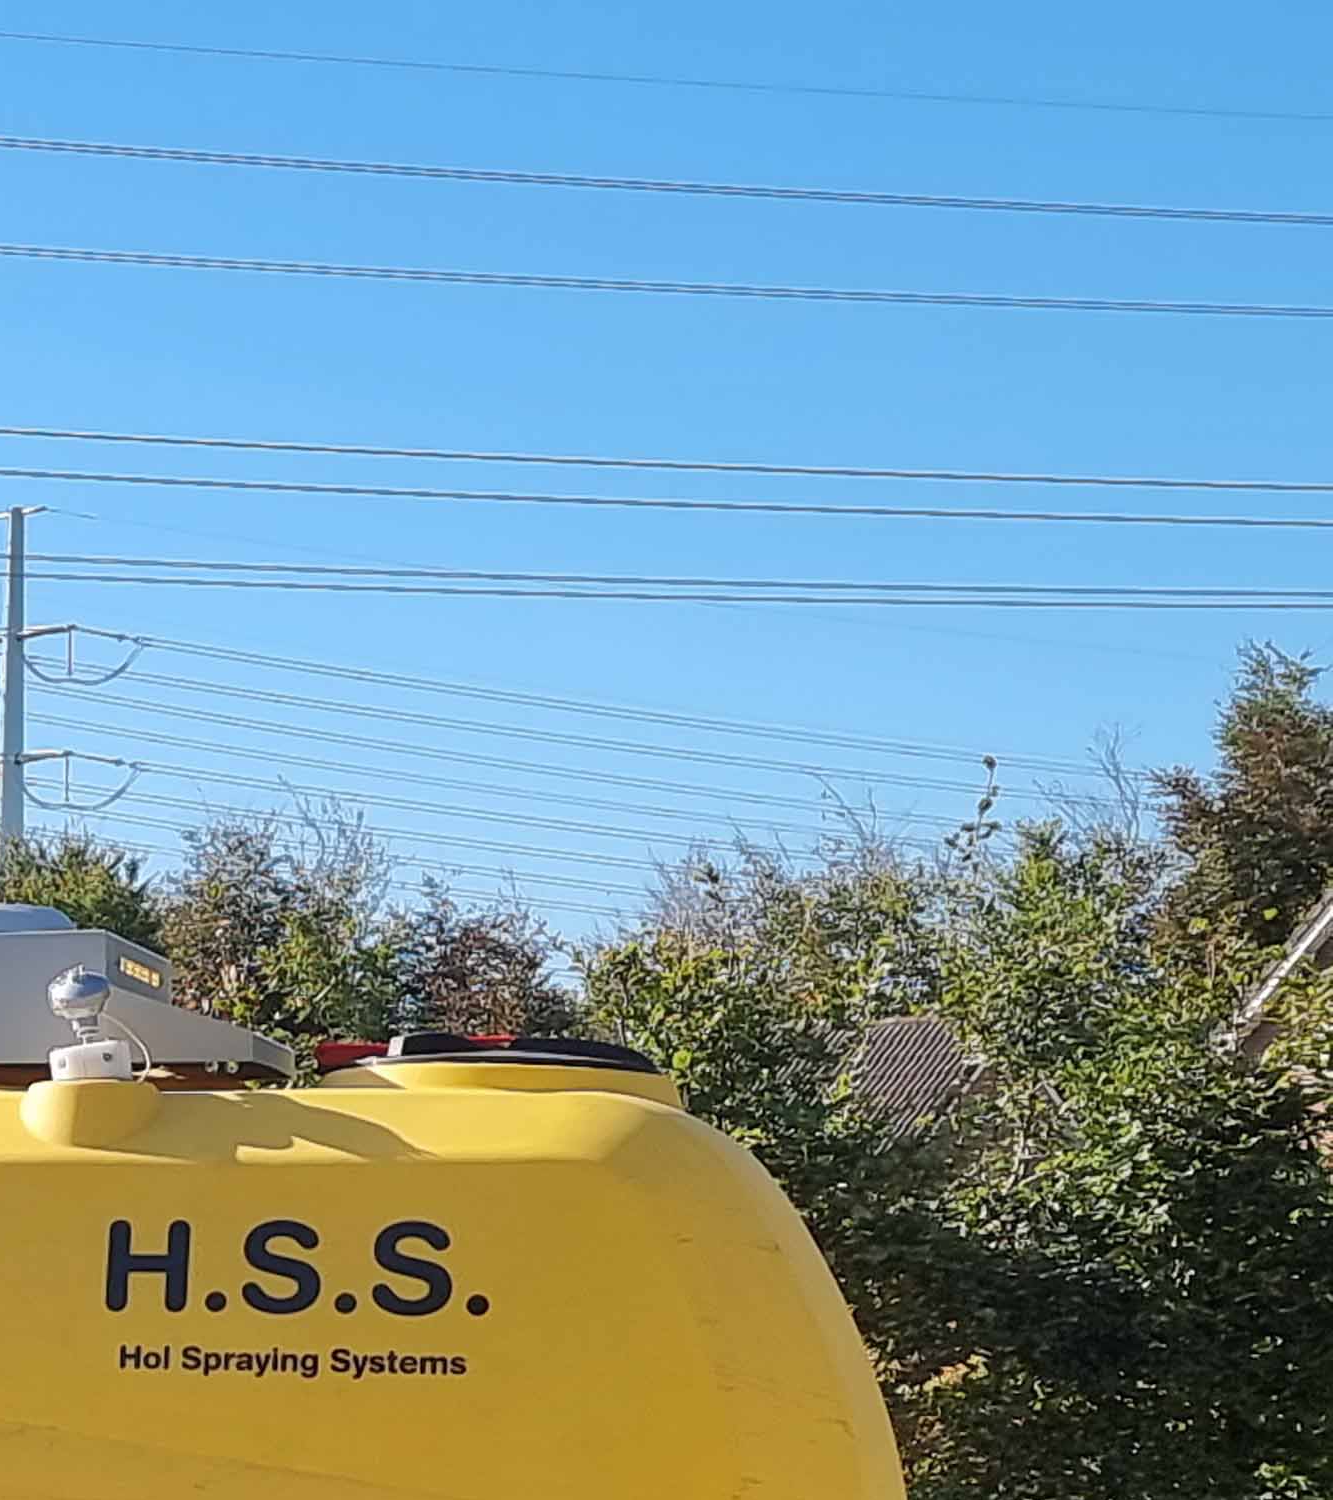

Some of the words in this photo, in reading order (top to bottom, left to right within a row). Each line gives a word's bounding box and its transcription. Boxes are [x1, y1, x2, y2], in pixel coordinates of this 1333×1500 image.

[105, 1219, 490, 1317] H.S.S.
[119, 1345, 171, 1371] Hol
[181, 1345, 319, 1379] Spraying
[330, 1348, 467, 1380] Systems
